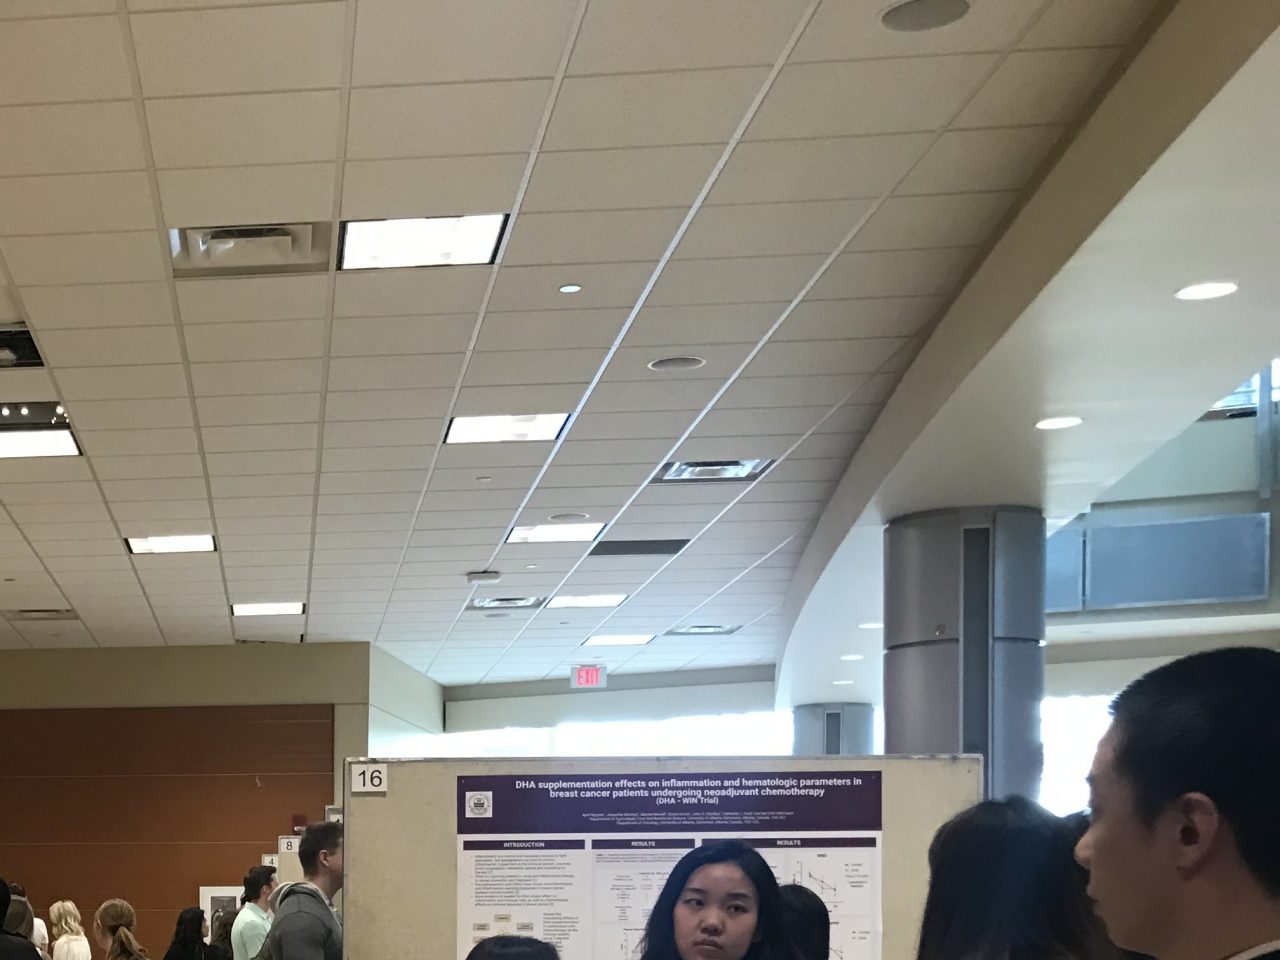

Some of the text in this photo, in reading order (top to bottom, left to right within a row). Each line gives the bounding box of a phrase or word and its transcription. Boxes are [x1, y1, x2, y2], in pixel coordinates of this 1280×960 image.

[576, 667, 600, 686] EXIT
[358, 770, 382, 787] 16
[538, 780, 612, 791] supplementation
[615, 780, 646, 788] effects
[662, 779, 721, 787] inflammation
[742, 778, 798, 788] hematologic
[800, 779, 851, 787] parameters
[550, 790, 578, 798] breast
[613, 789, 648, 798] patients
[651, 789, 702, 798] undergoing
[704, 788, 758, 798] neoadjuvant
[761, 788, 824, 797] chemotherapy
[656, 798, 675, 806] (DHA
[700, 797, 719, 805] Trial)
[286, 841, 292, 850] 8
